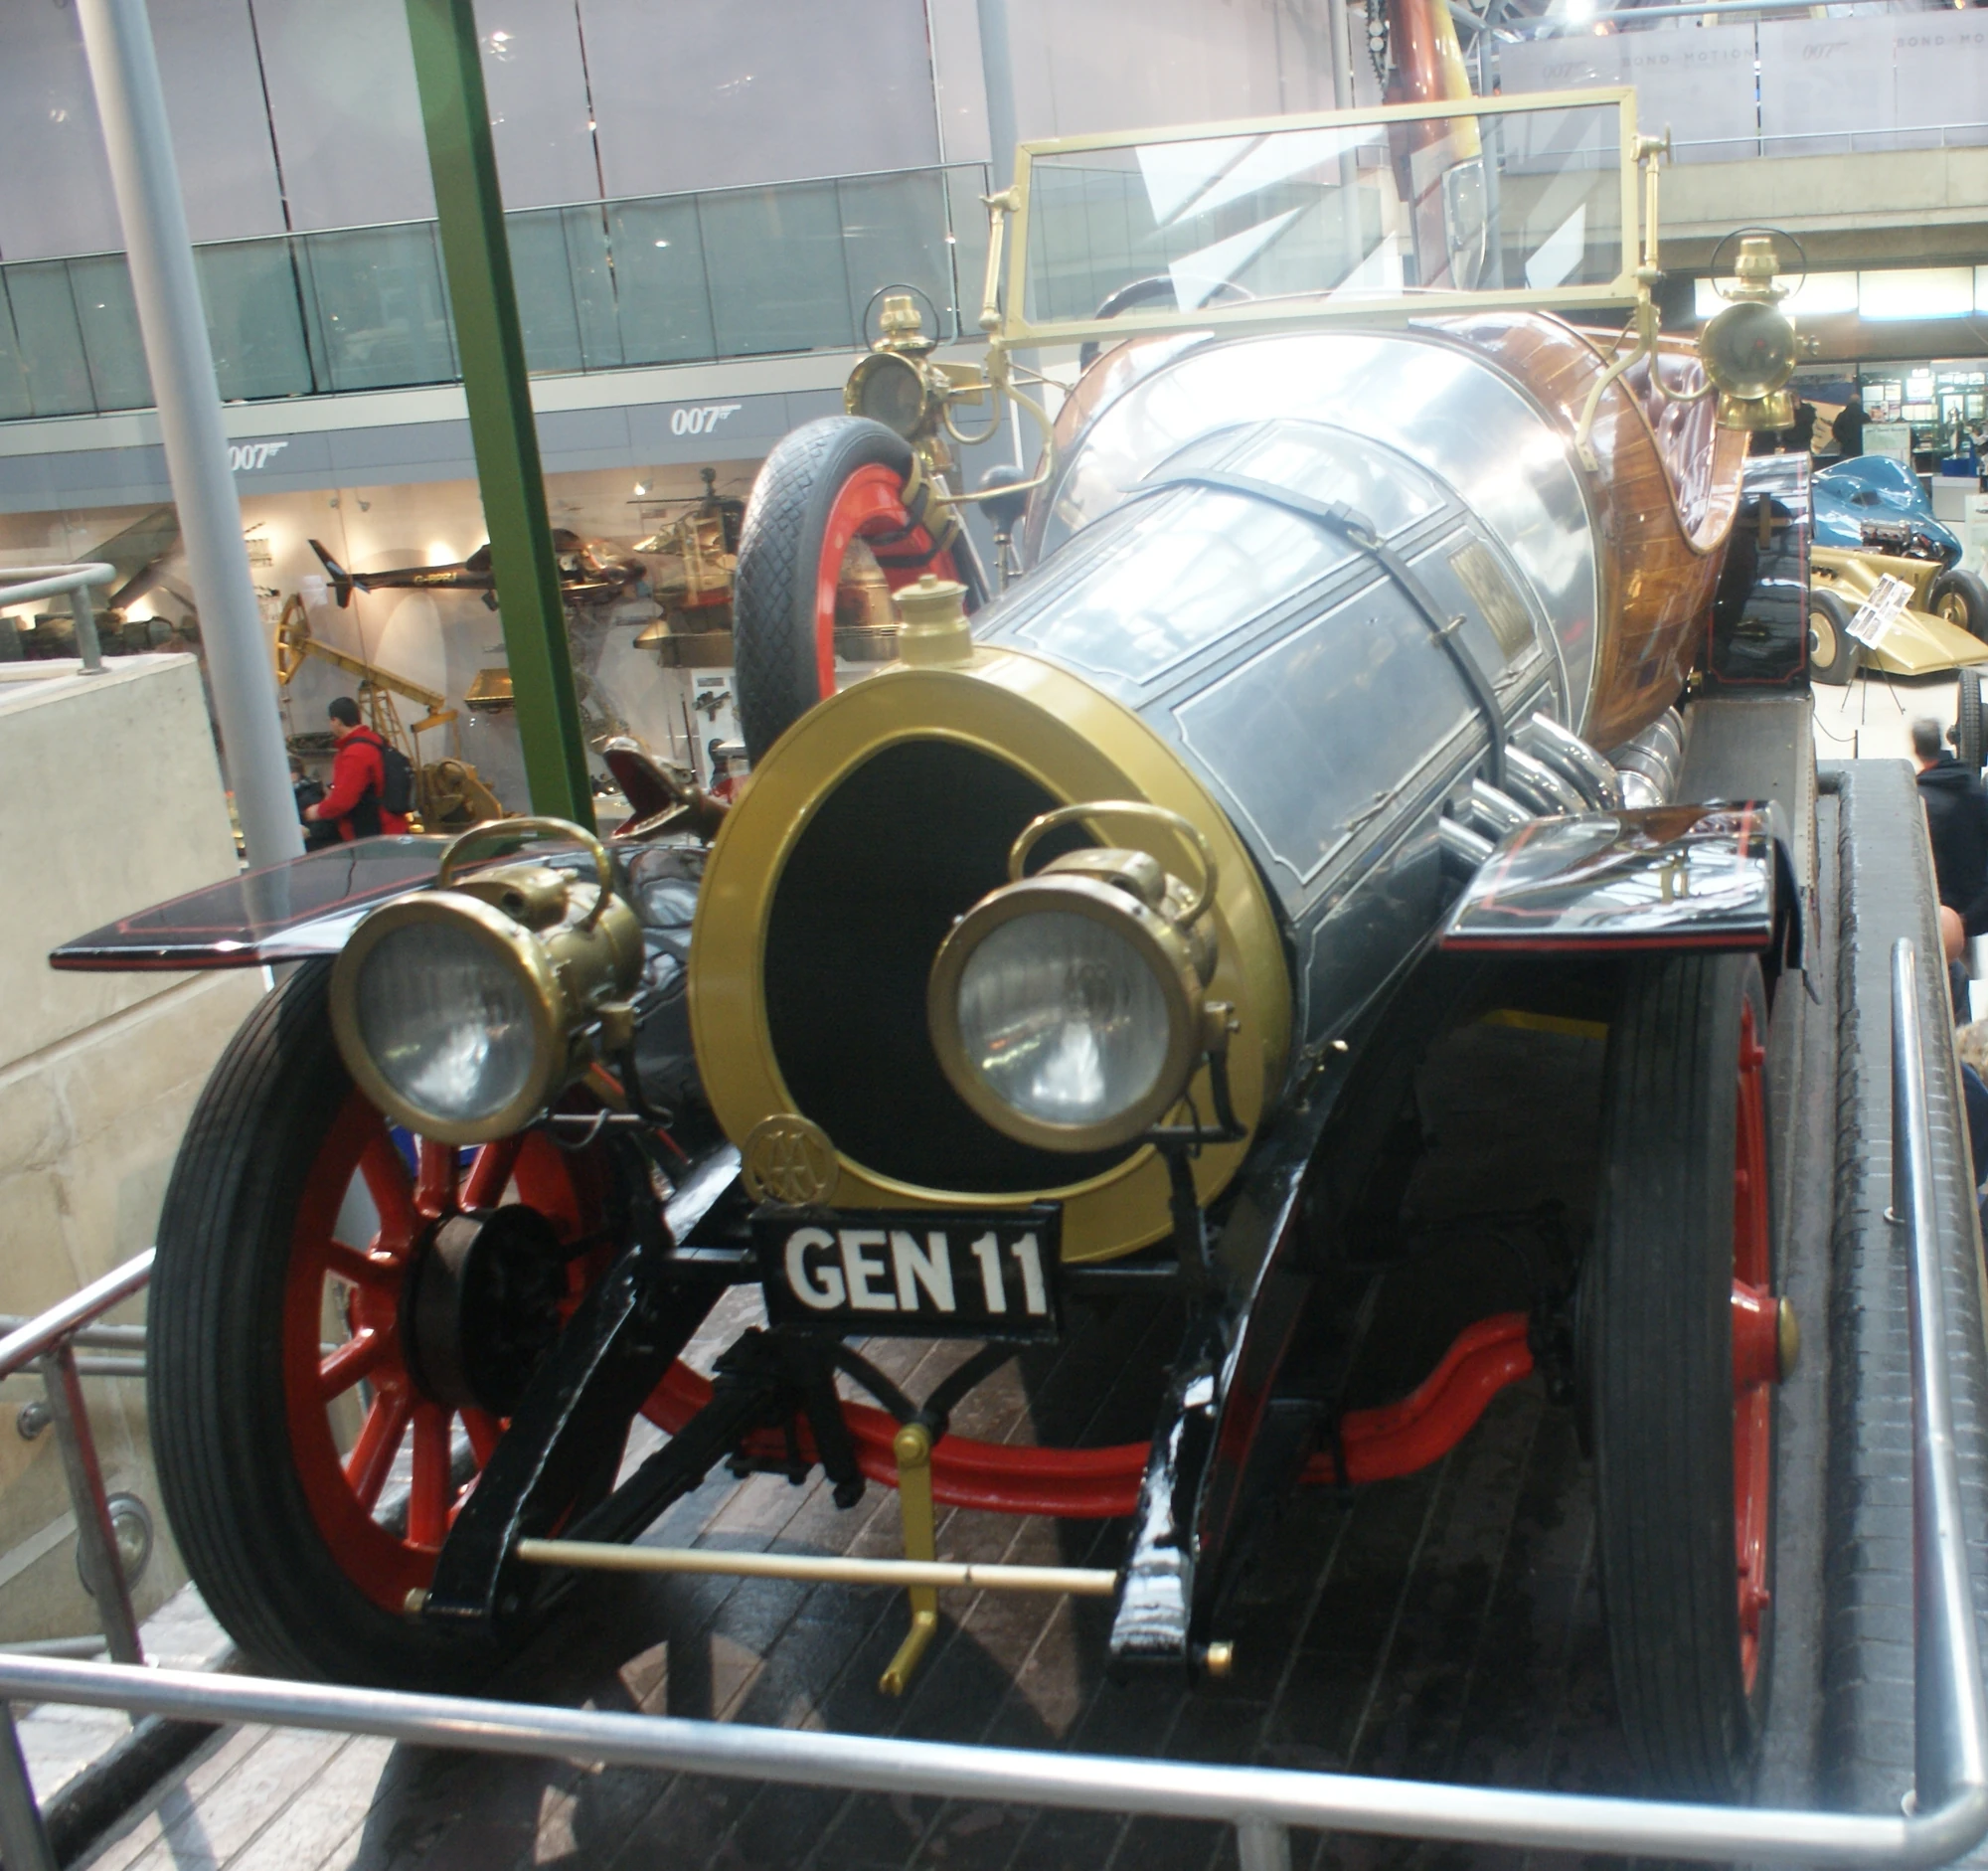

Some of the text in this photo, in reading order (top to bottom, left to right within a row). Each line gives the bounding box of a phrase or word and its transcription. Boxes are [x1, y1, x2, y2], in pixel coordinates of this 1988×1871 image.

[1803, 41, 1850, 60] 007
[1897, 35, 1945, 48] BOND
[1542, 48, 1753, 79] 007 BOND MOTION
[670, 404, 743, 435] 007
[784, 1227, 1048, 1315] GEN 11
